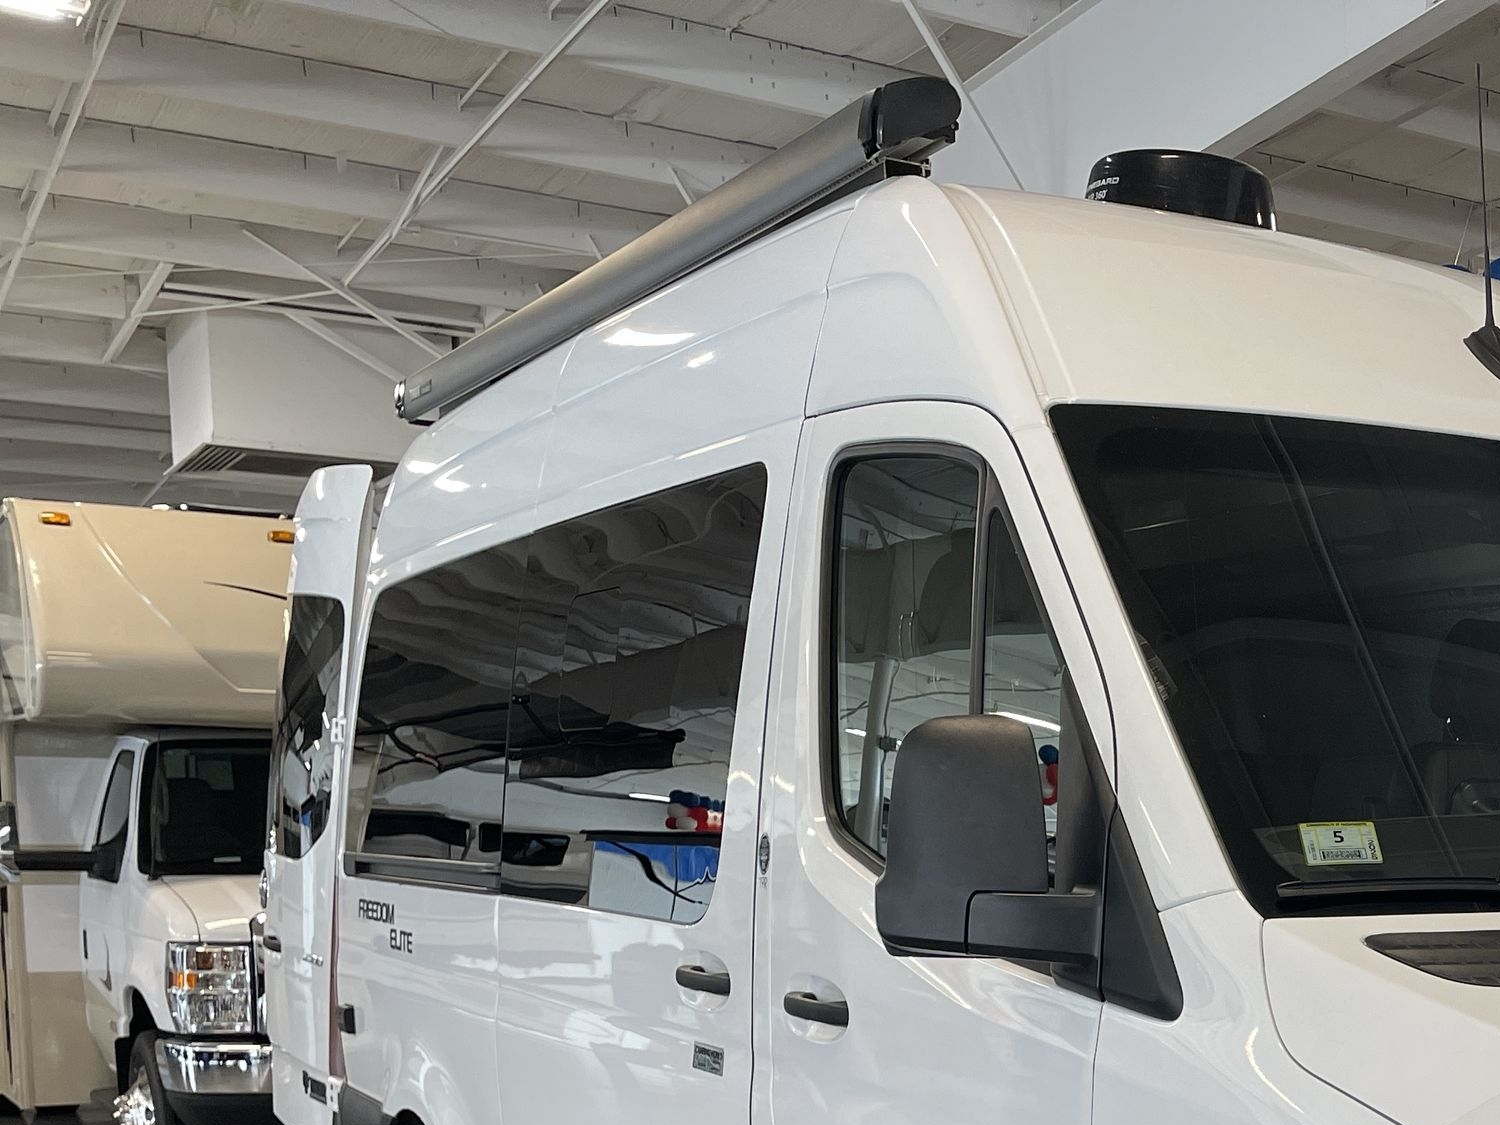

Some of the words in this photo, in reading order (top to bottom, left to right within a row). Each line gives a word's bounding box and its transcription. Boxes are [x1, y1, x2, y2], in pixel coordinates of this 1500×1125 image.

[1333, 831, 1345, 843] 5
[358, 898, 395, 925] FREEDOM
[389, 928, 413, 954] ELITE
